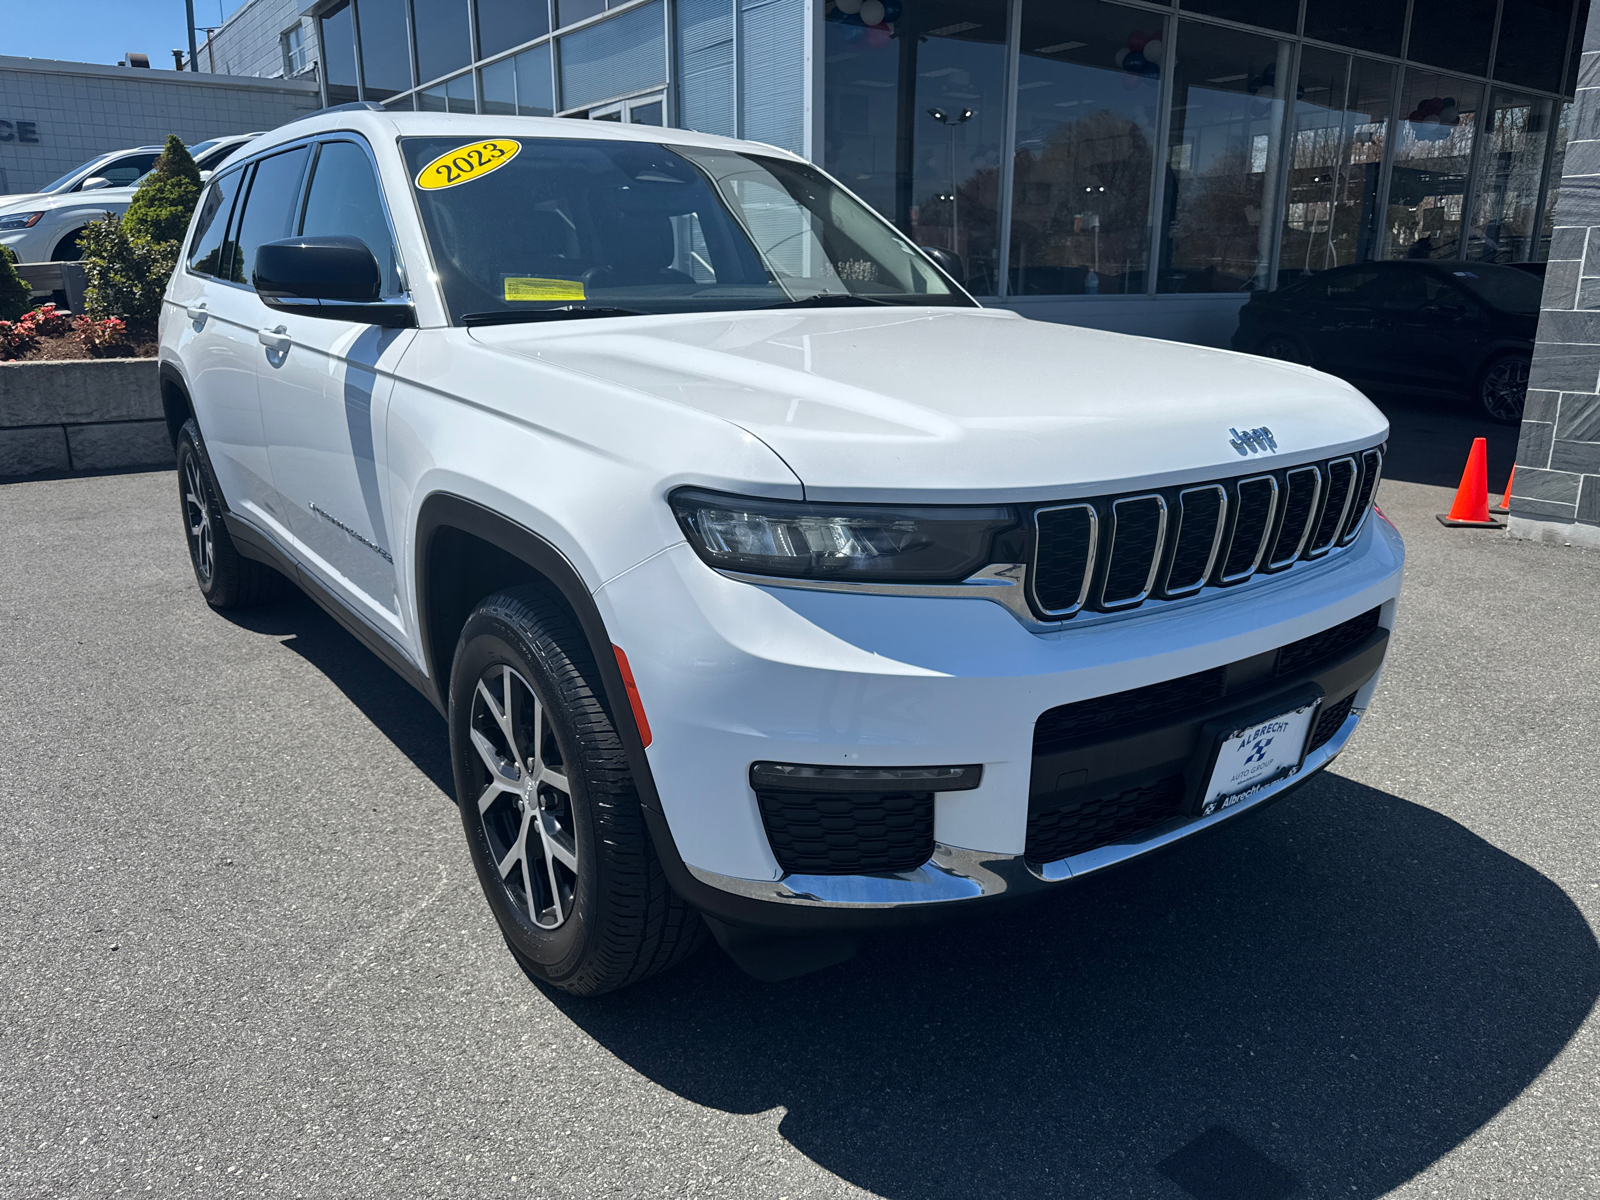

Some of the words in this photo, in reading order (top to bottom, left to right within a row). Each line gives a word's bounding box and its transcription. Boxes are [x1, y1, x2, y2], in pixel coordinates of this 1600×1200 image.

[436, 143, 505, 183] 2023
[1229, 426, 1276, 453] Jeep
[1237, 722, 1289, 752] ALBRECHT
[1230, 769, 1249, 783] AUTO
[1250, 759, 1274, 774] GROUP
[1221, 784, 1261, 809] Albrecht
